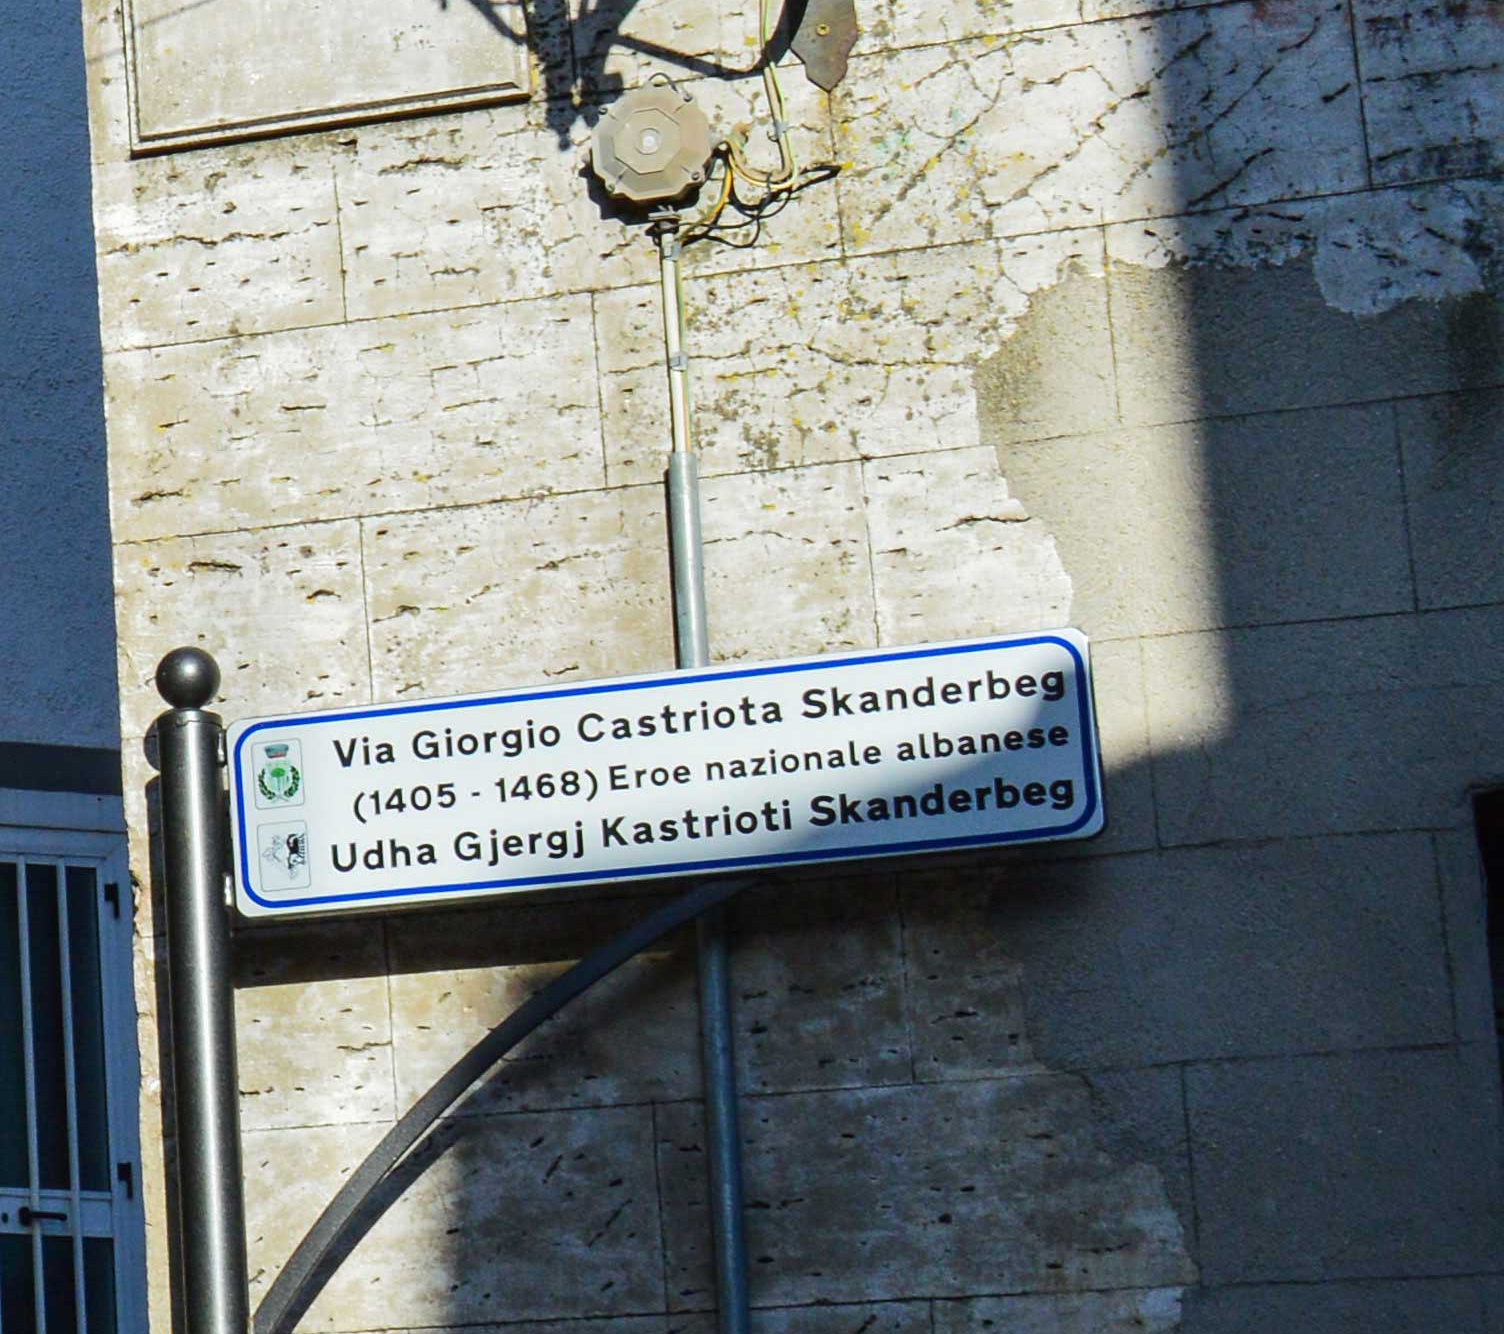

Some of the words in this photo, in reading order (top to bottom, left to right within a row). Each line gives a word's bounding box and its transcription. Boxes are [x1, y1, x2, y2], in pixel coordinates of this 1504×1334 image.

[333, 737, 396, 768] Via
[412, 719, 561, 759] Giorgio
[577, 696, 782, 743] Castriota
[801, 670, 1065, 719] Skanderbeg
[353, 783, 457, 824] (1405
[494, 769, 598, 803] 1468)
[608, 764, 692, 791] Eroe
[706, 741, 882, 781] nazionale
[897, 725, 1069, 762] albanese
[331, 838, 438, 872] Udha
[453, 820, 585, 867] Gjergj
[601, 800, 792, 848] Kastrioti
[808, 777, 1076, 827] Skanderbeg
